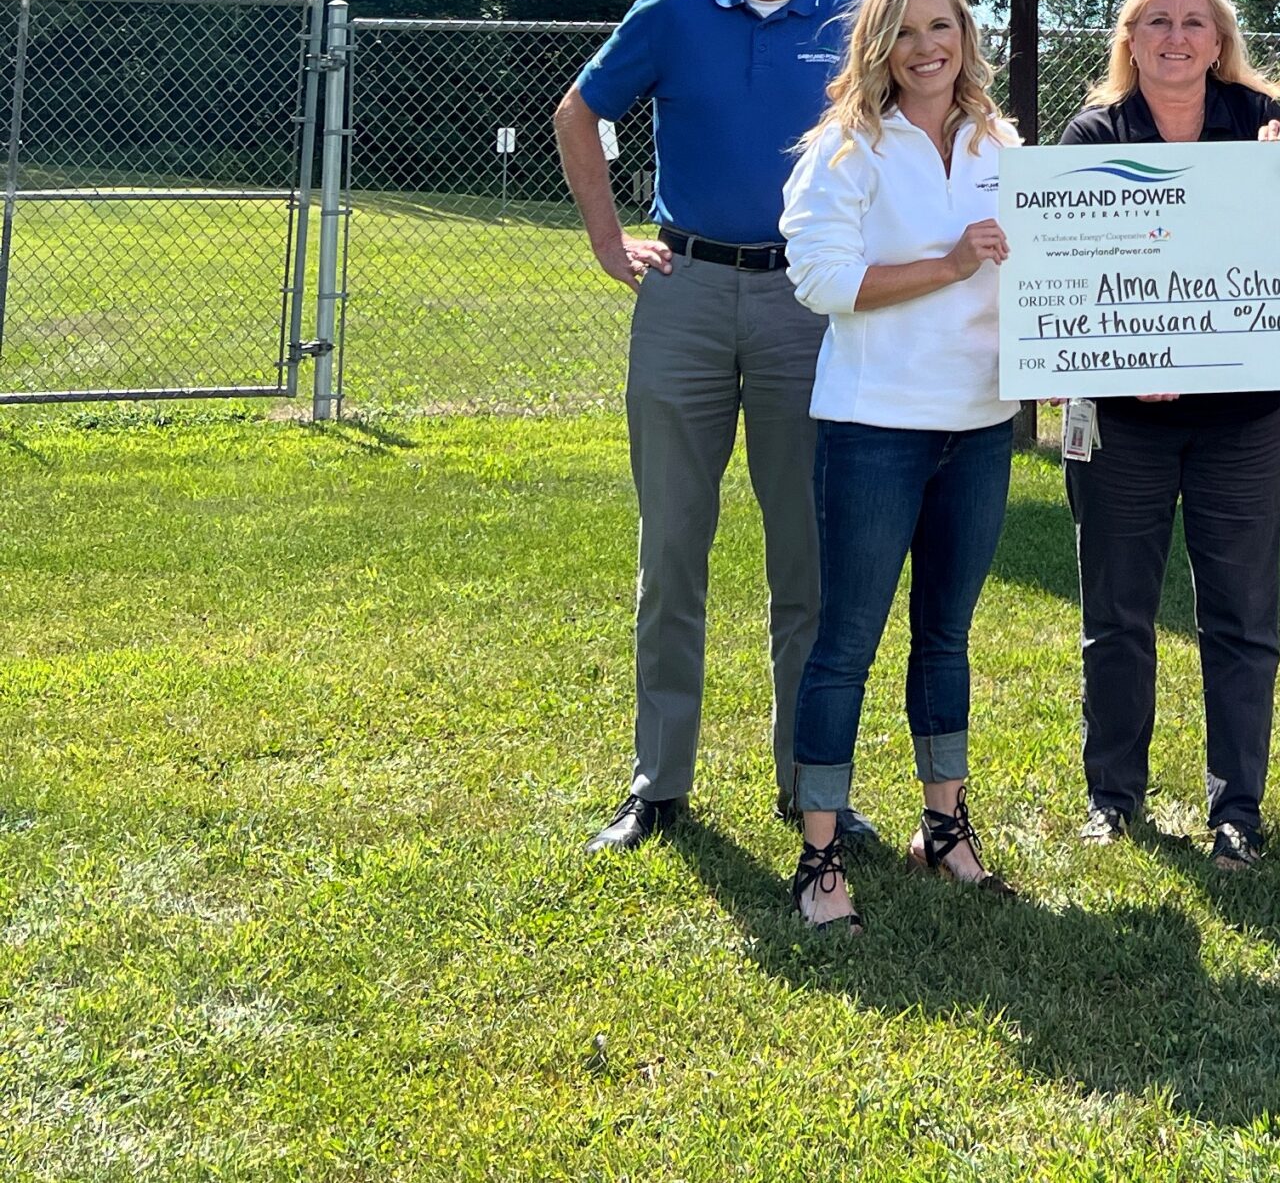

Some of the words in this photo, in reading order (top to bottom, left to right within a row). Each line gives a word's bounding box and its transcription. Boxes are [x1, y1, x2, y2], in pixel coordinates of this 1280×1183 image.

[1015, 189, 1117, 209] DAIRYLAND
[1121, 188, 1187, 207] POWER
[1043, 209, 1161, 220] COOPERATIVE
[1106, 231, 1147, 242] Cooperative
[1046, 247, 1161, 258] www.DairylandPower.com
[1018, 280, 1042, 291] PAY
[1045, 279, 1064, 290] TO
[1065, 278, 1089, 289] THE
[1096, 272, 1160, 305] Alma
[1167, 270, 1220, 303] Area
[1018, 295, 1066, 307] ORDER
[1068, 295, 1088, 306] OF
[1037, 313, 1091, 340] Five
[1098, 310, 1218, 335] thousand
[1018, 358, 1046, 370] FOR
